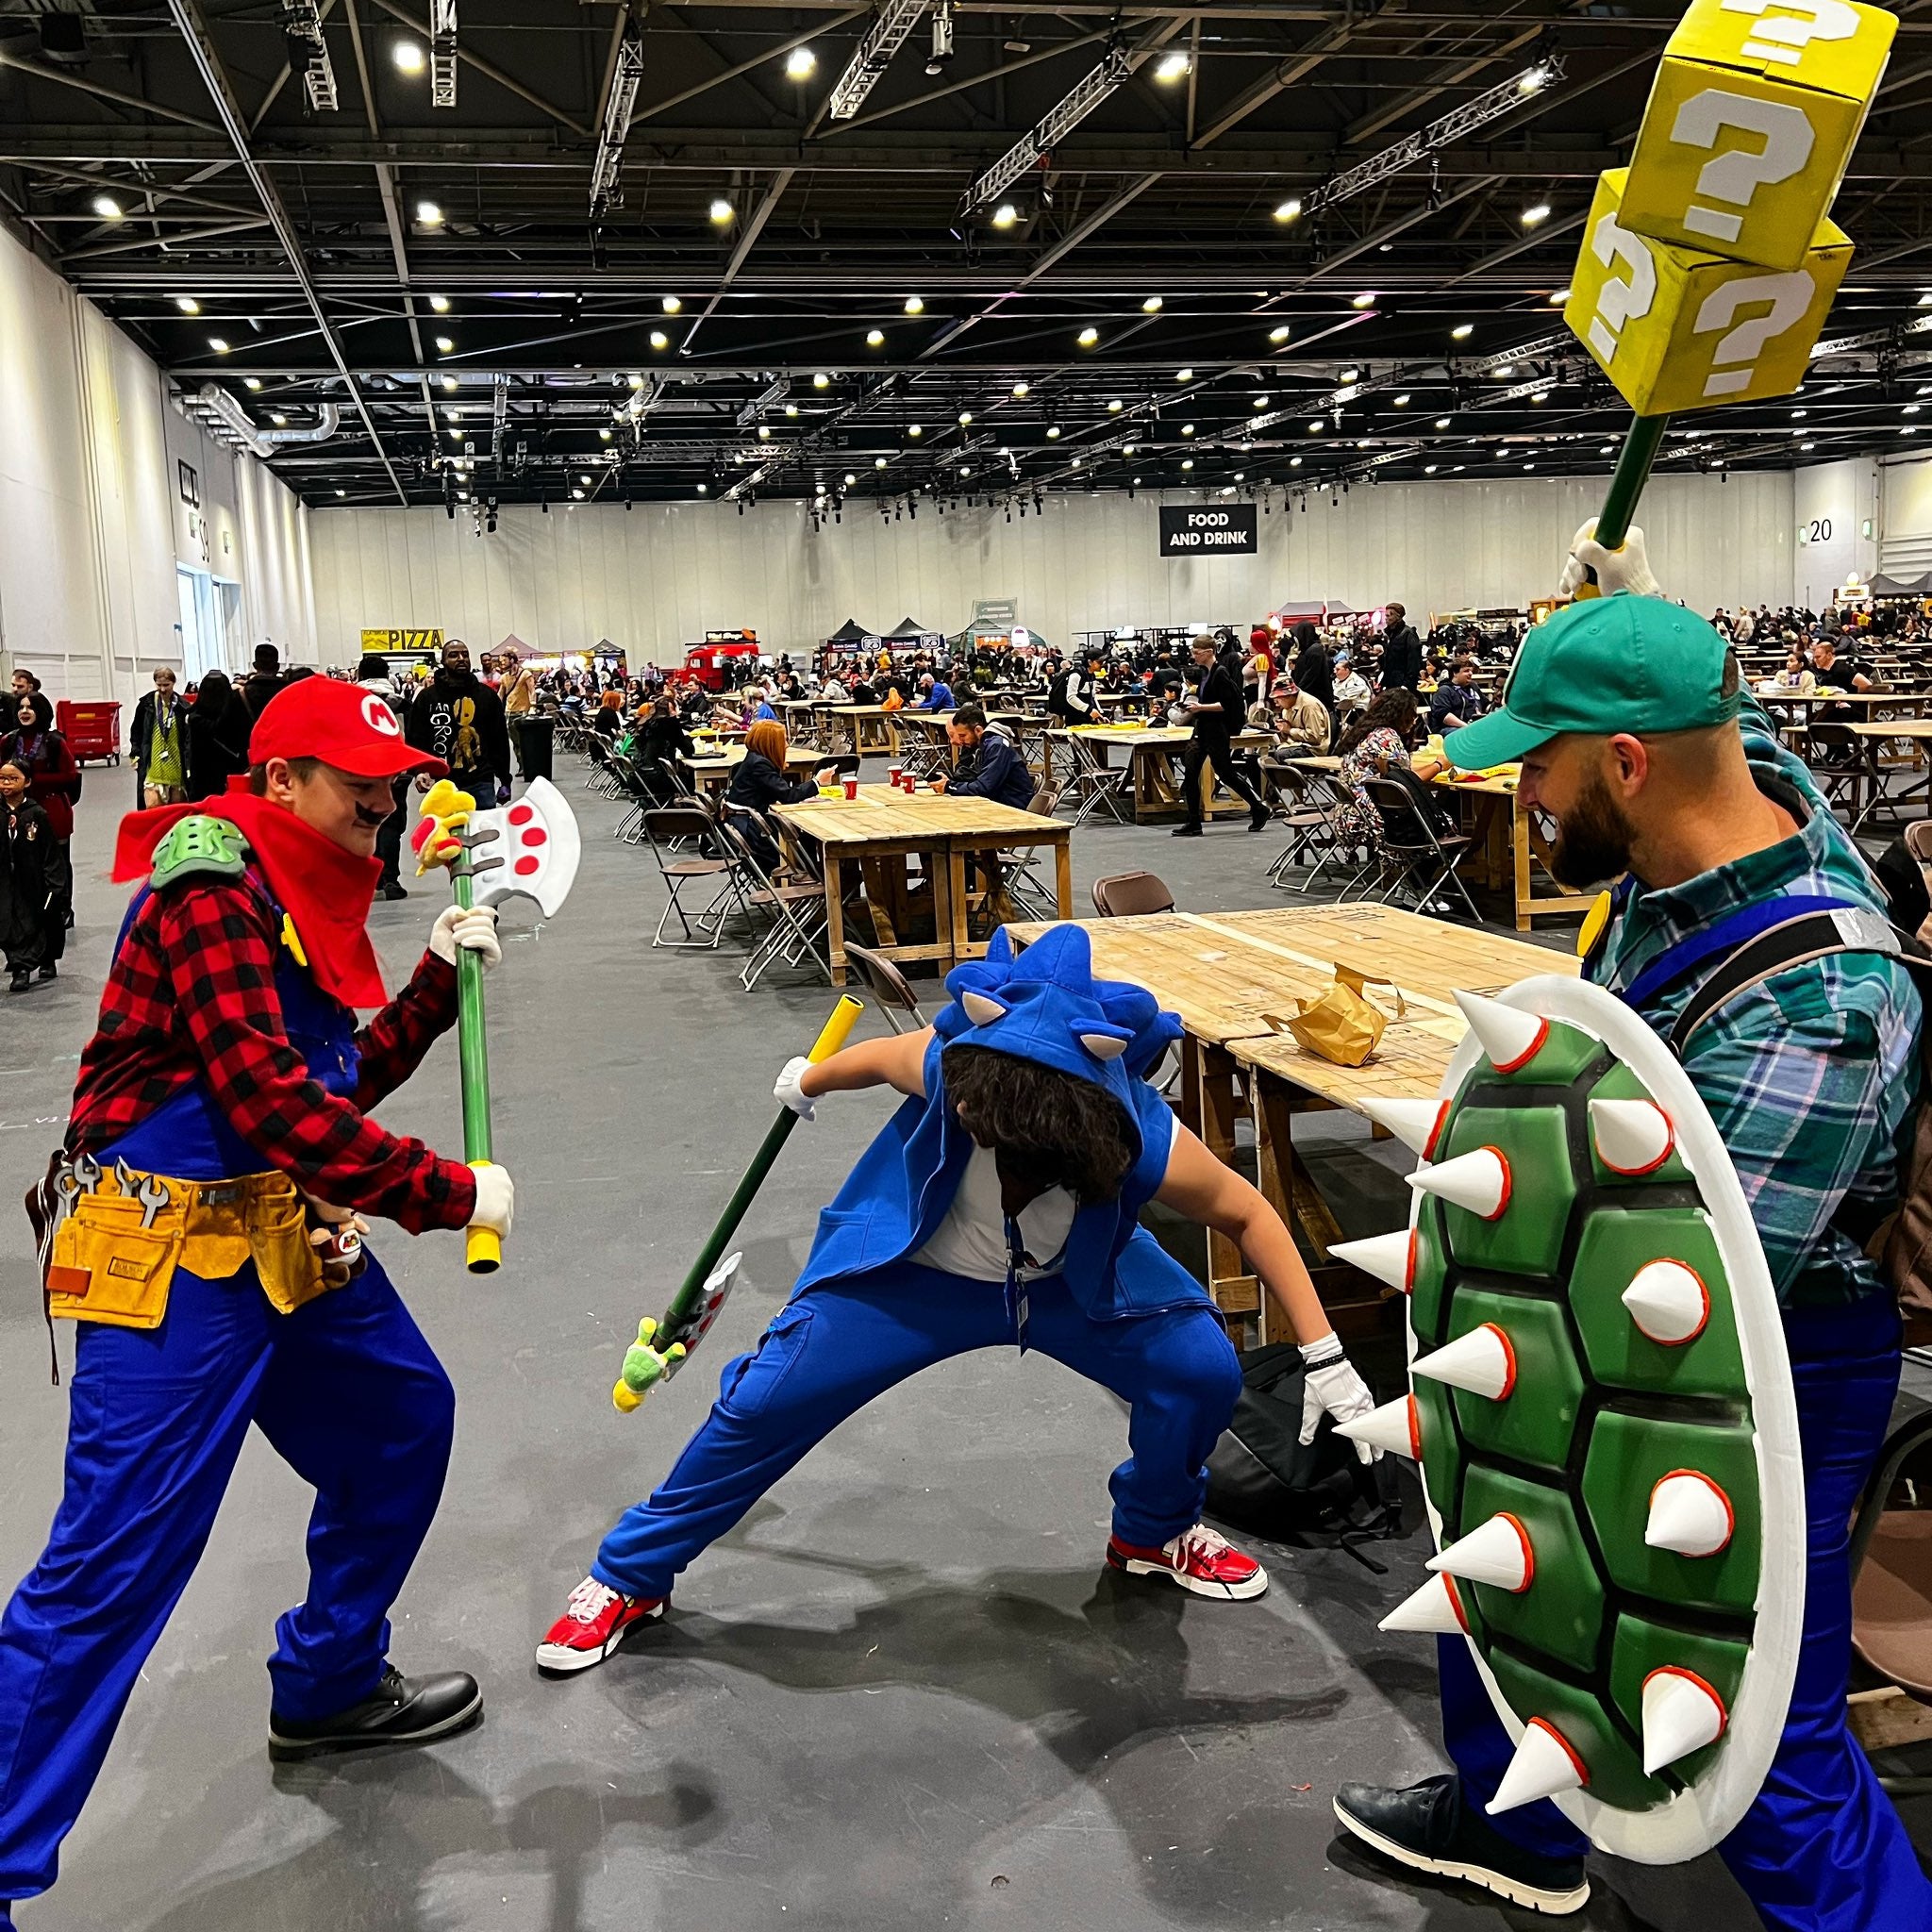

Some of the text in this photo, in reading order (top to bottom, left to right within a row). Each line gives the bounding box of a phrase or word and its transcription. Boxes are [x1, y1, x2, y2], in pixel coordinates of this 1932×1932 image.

[1720, 0, 1861, 67] ?
[1670, 88, 1816, 243] ?
[1589, 211, 1658, 366] ?
[1693, 270, 1816, 397] ?
[1188, 512, 1229, 527] FOOD
[1810, 519, 1832, 542] 20
[1170, 530, 1247, 546] AND DRINK
[388, 629, 443, 650] PIZZA
[369, 702, 397, 729] M
